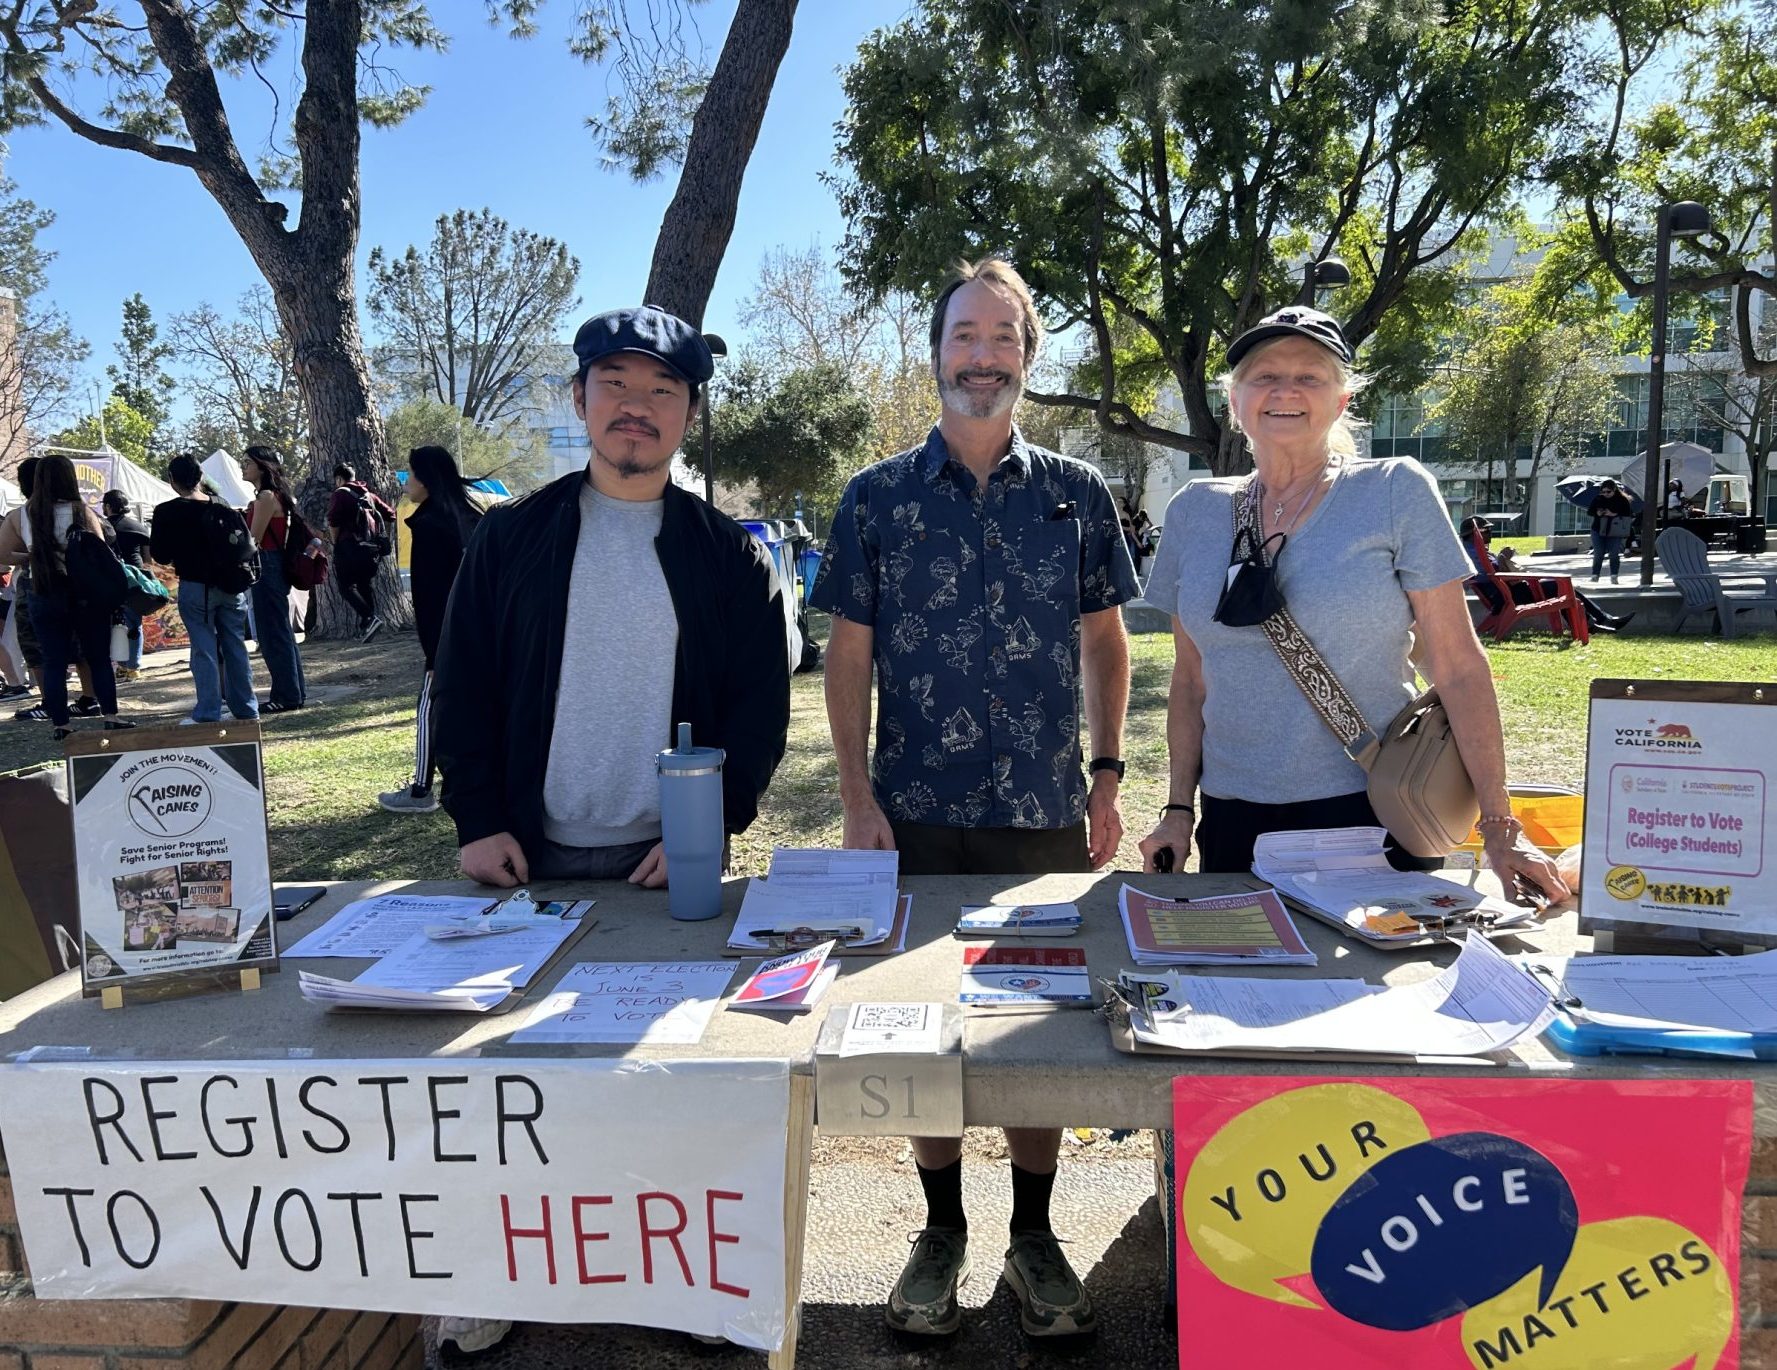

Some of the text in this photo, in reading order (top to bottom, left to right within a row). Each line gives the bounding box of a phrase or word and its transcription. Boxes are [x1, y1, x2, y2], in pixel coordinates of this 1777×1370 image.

[1615, 728, 1653, 737] VOTE
[1614, 738, 1702, 748] CALIFORNIA
[120, 765, 139, 782] JOIN
[139, 756, 159, 768] THE
[157, 801, 199, 816] CANES
[1627, 807, 1743, 831] Register to Vote
[121, 837, 226, 855] Save Senior Programs!
[1626, 831, 1743, 858] (College Students)
[120, 846, 228, 864] Fight for Senior Rights!
[190, 885, 224, 894] ATTENTION
[389, 899, 450, 907] Reasons
[169, 951, 206, 961] information
[574, 964, 737, 976] NEXT ELECTION
[596, 981, 684, 994] JUNE 3
[616, 995, 700, 1006] READY
[561, 1013, 591, 1022] TO
[860, 1074, 920, 1119] S1
[83, 1074, 550, 1166] REGISTER
[1210, 1120, 1388, 1223] YOUR
[1345, 1168, 1531, 1285] VOICE
[42, 1185, 751, 1299] TO VOTE HERE
[1472, 1240, 1712, 1370] MATTERS
